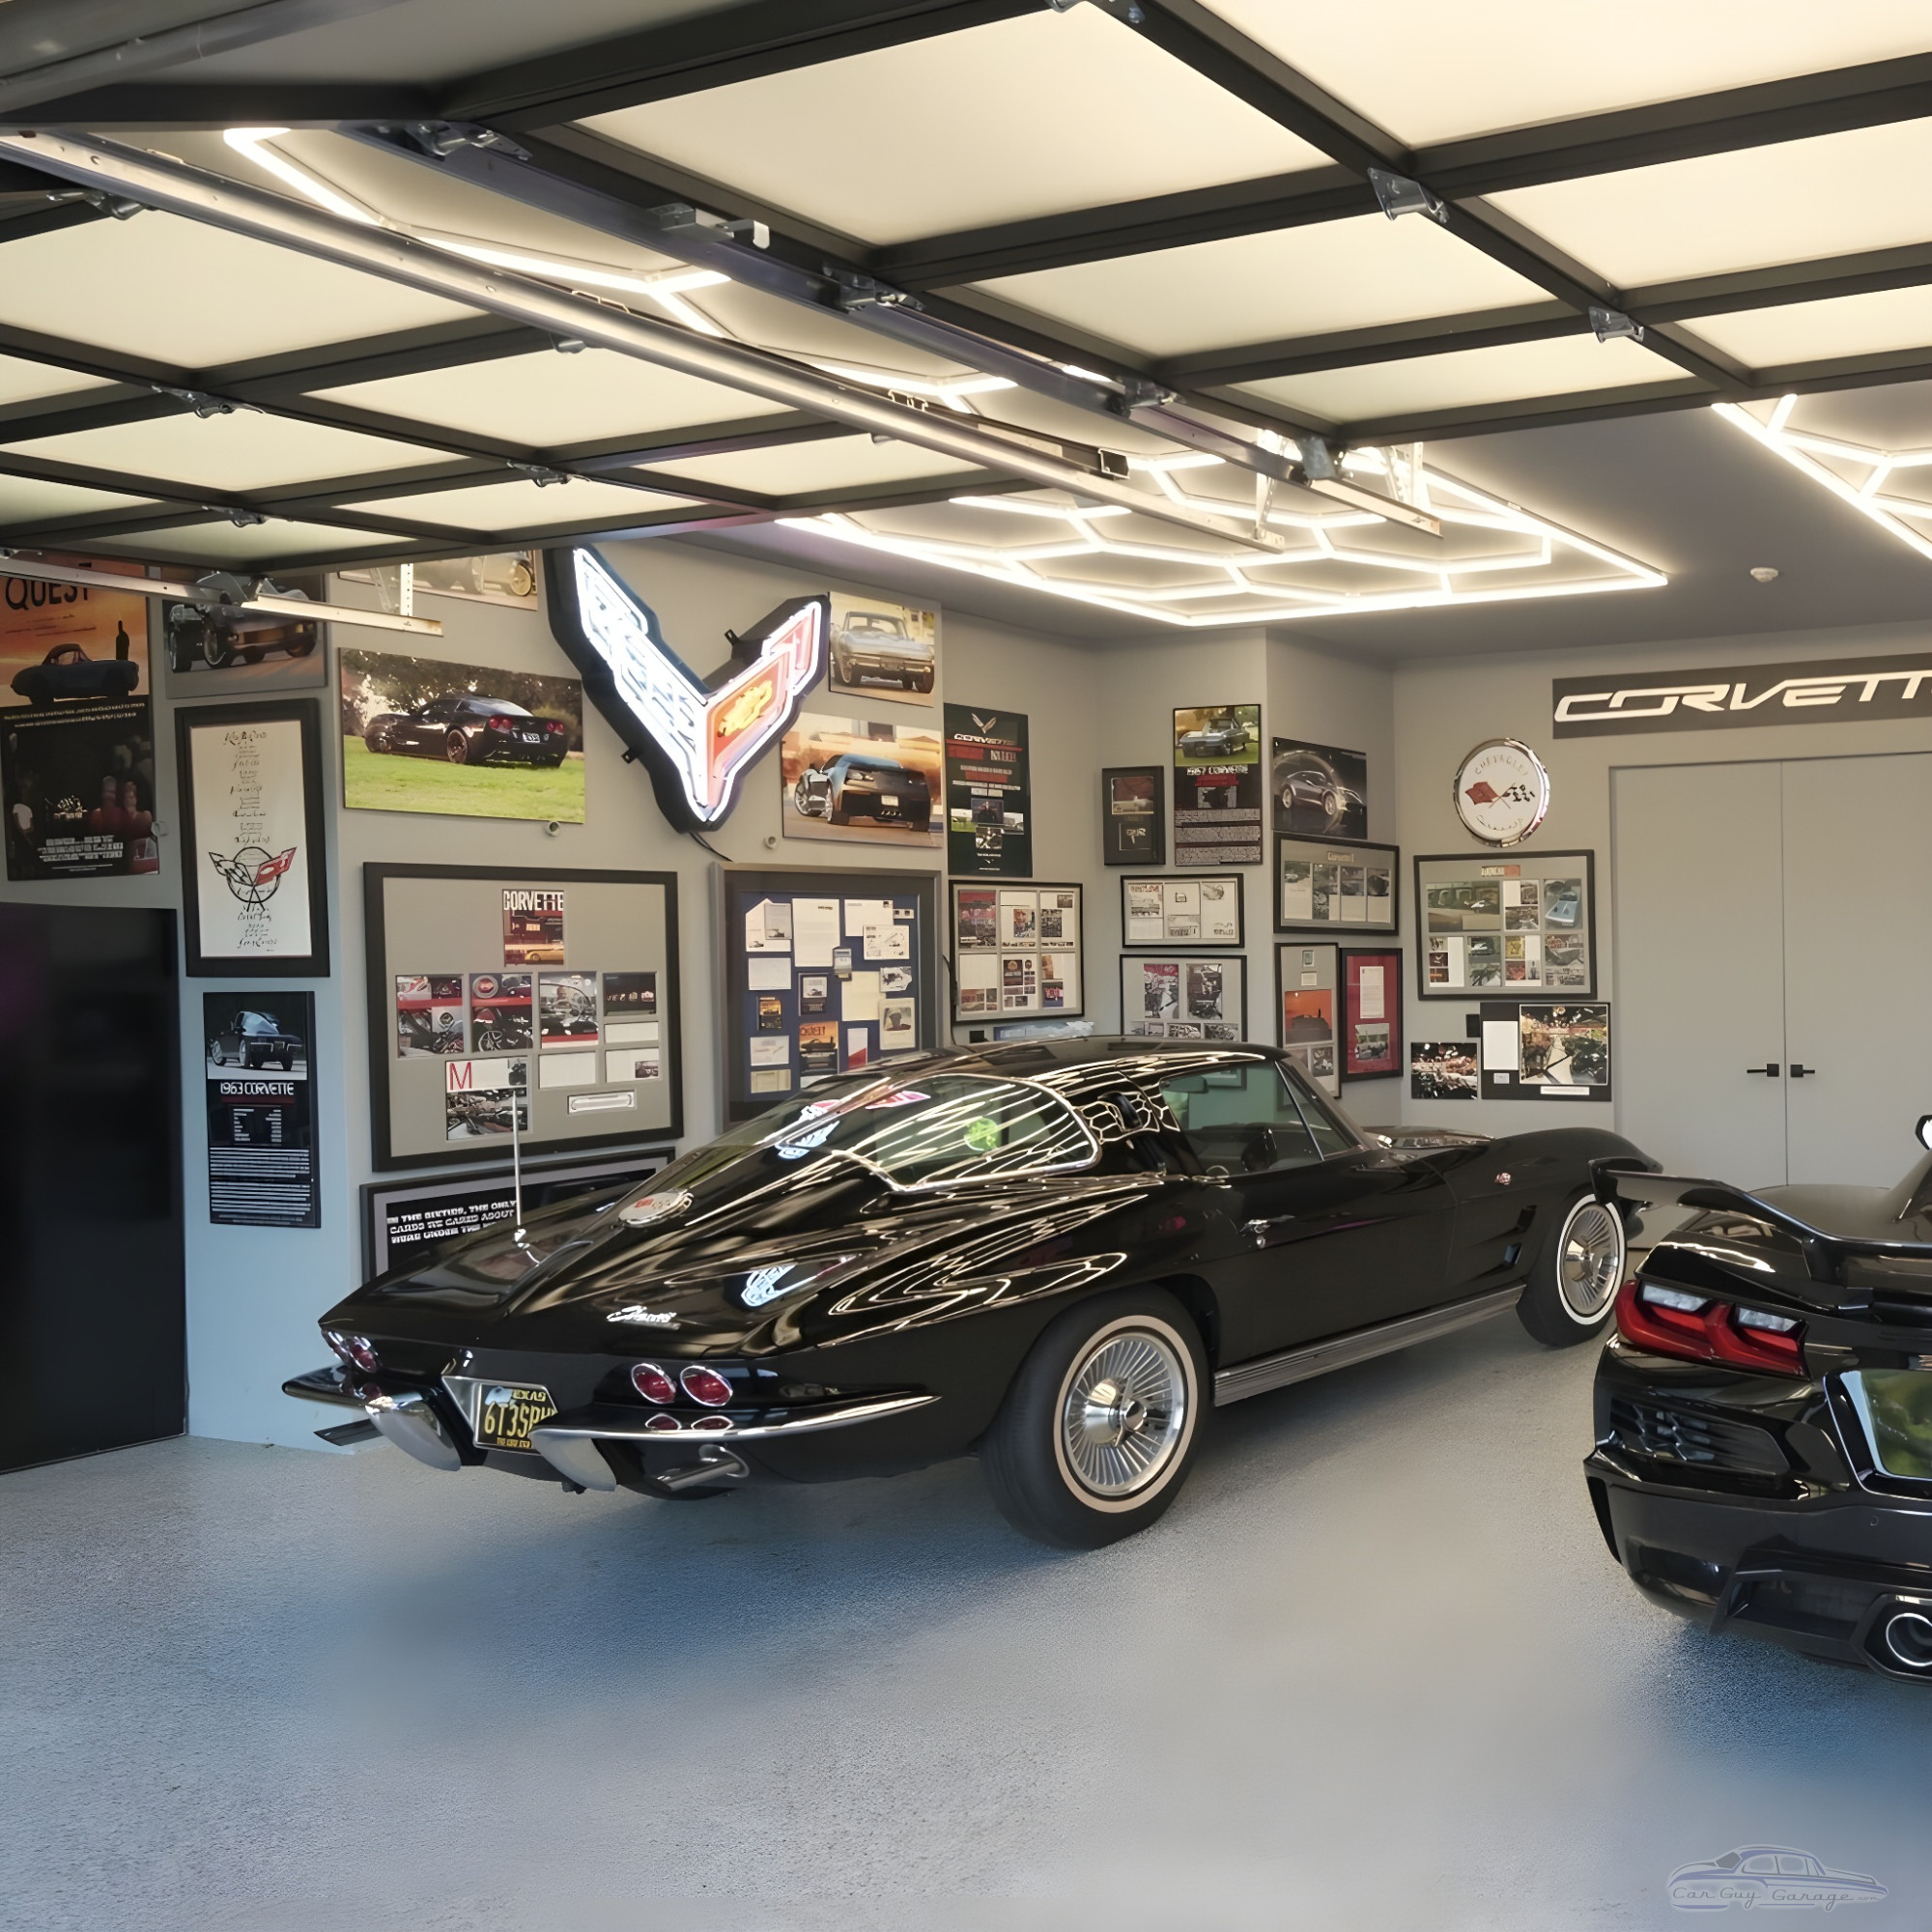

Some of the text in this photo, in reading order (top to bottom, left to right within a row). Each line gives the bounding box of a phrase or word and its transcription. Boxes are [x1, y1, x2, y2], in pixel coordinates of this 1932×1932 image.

[1554, 669, 1932, 723] CORVETT
[503, 891, 564, 912] CORVETTE
[220, 1082, 294, 1095] 1963 CORVETTE
[449, 1062, 472, 1091] M
